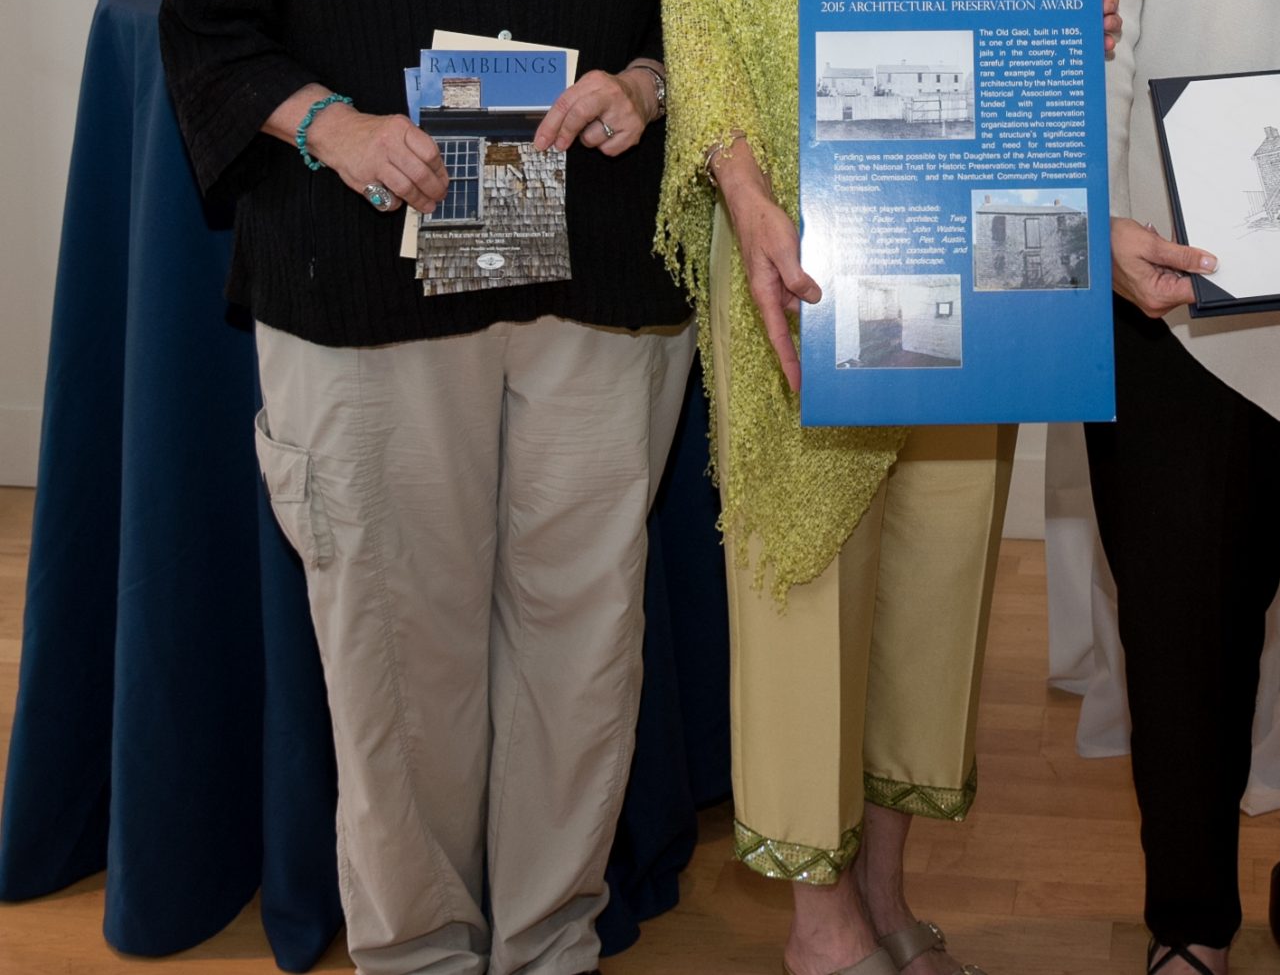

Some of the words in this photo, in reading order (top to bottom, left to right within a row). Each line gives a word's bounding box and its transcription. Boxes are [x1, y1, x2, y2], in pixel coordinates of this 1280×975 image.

[820, 1, 845, 13] 2015
[849, 0, 948, 13] ARCHITECTURAL
[951, 0, 1036, 12] PRESERVATION
[1040, 0, 1083, 10] AWARD
[996, 28, 1009, 36] Old
[1034, 28, 1049, 36] built
[979, 49, 994, 58] jails
[430, 57, 557, 73] RAMBLINGS
[980, 59, 1004, 67] careful
[1009, 59, 1053, 68] preservation
[1004, 69, 1035, 77] example
[1061, 69, 1084, 77] prison
[1024, 80, 1033, 88] by
[1047, 79, 1084, 87] Nantucket
[981, 100, 1005, 108] funded
[1006, 111, 1032, 119] leading
[1041, 110, 1085, 118] preservation
[981, 121, 1029, 130] organizations
[1046, 120, 1085, 128] recognized
[981, 131, 992, 139] the
[1043, 131, 1085, 139] significance
[906, 153, 936, 161] possible
[938, 153, 947, 161] by
[963, 152, 1000, 160] Daughters
[1027, 151, 1061, 159] American
[873, 163, 903, 171] National
[939, 162, 966, 170] Historic
[997, 172, 1038, 181] Community
